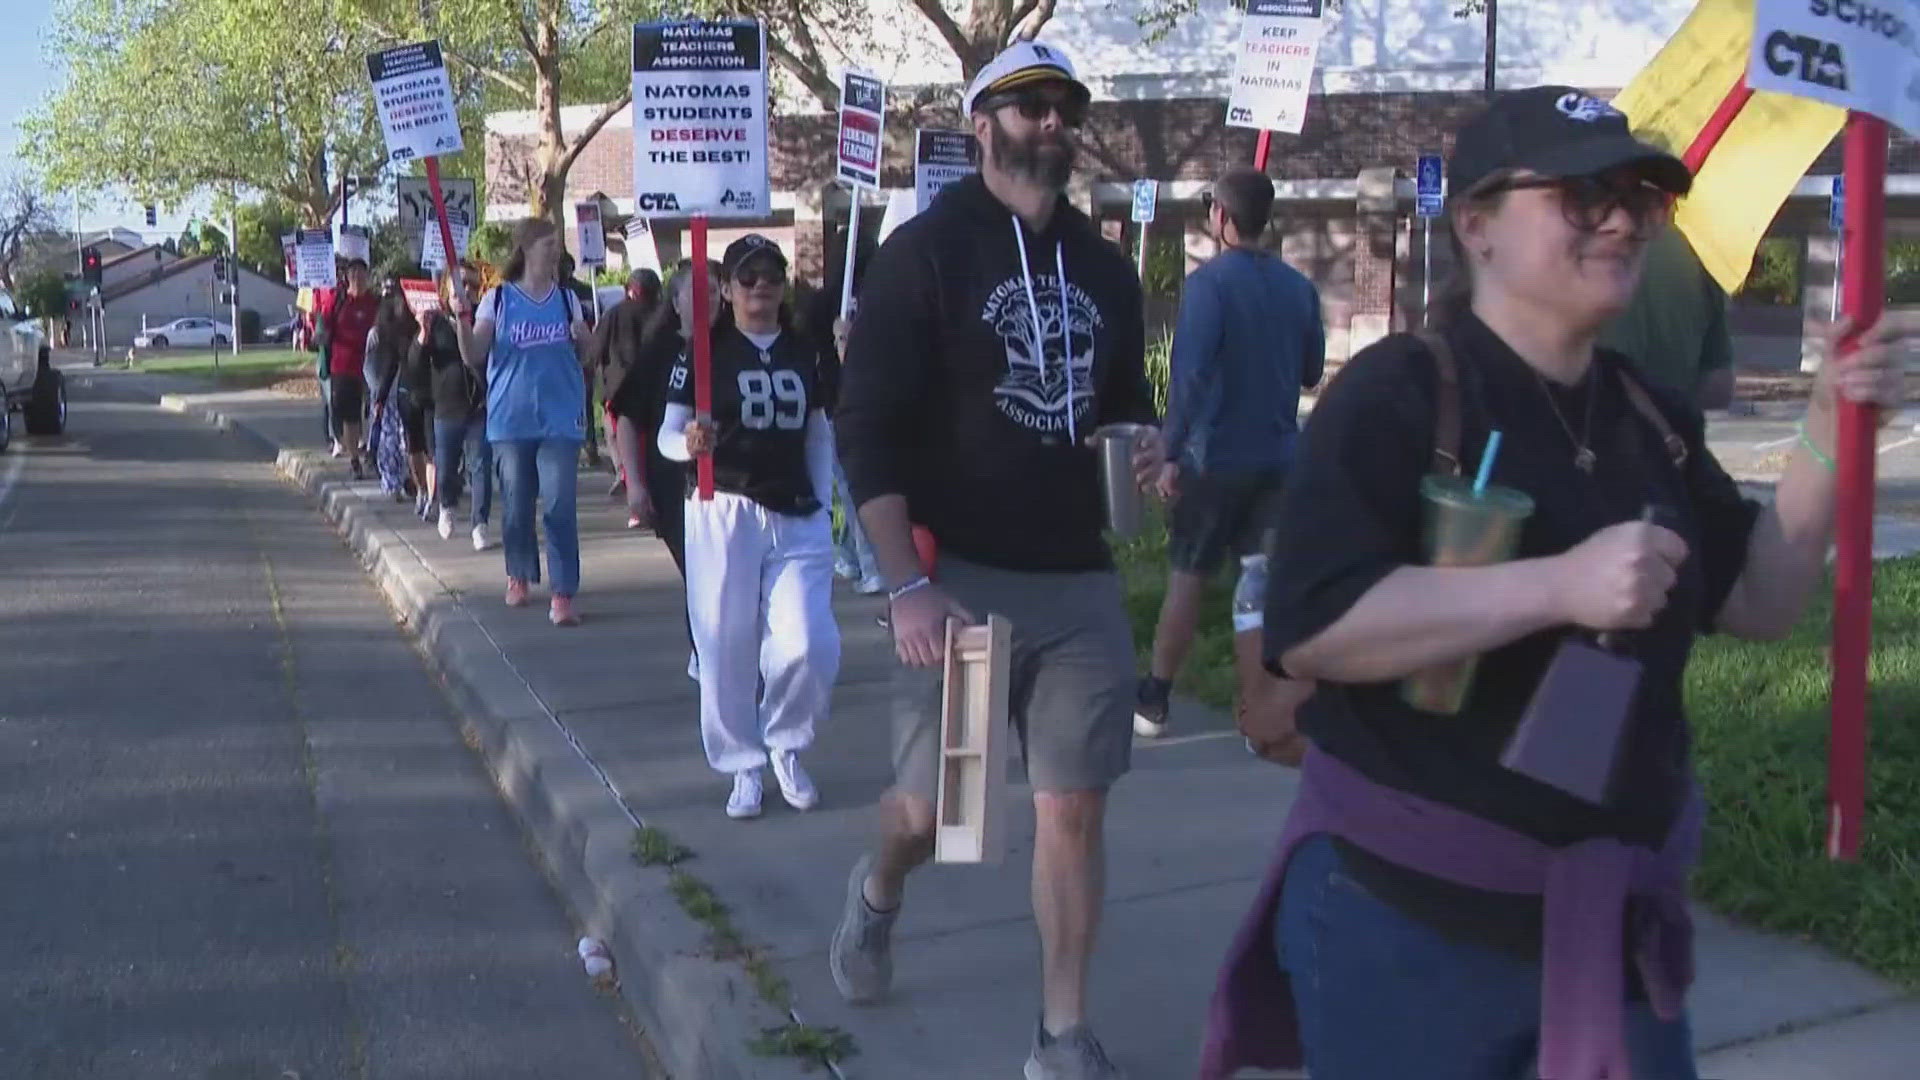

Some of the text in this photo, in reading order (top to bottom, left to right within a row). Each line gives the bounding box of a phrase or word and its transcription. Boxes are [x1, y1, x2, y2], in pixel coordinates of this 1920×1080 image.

[1256, 4, 1313, 14] ASSOCIATION
[662, 26, 733, 38] NATOMAS
[1262, 26, 1298, 39] KEEP
[661, 41, 735, 52] TEACHERS
[1246, 42, 1310, 56] TEACHERS
[652, 55, 745, 67] ASSOCIATION
[1267, 59, 1281, 72] IN
[1764, 28, 1849, 91] CTA
[380, 76, 441, 97] NATOMAS
[1240, 75, 1302, 90] NATOMAS
[645, 84, 751, 98] NATOMAS
[383, 89, 444, 109] STUDENTS
[389, 102, 444, 120] DESERVE
[644, 107, 753, 120] STUDENTS
[1230, 107, 1253, 122] CTA
[391, 113, 448, 132] THE BEST!
[650, 129, 747, 141] DESERVE
[392, 146, 415, 161] CTA
[648, 150, 751, 163] THE BEST!
[639, 192, 681, 211] CTA
[1036, 274, 1104, 328] TECHERS
[510, 321, 567, 345] Kings
[737, 369, 806, 430] 89
[996, 397, 1090, 432] ASSOCIATON
